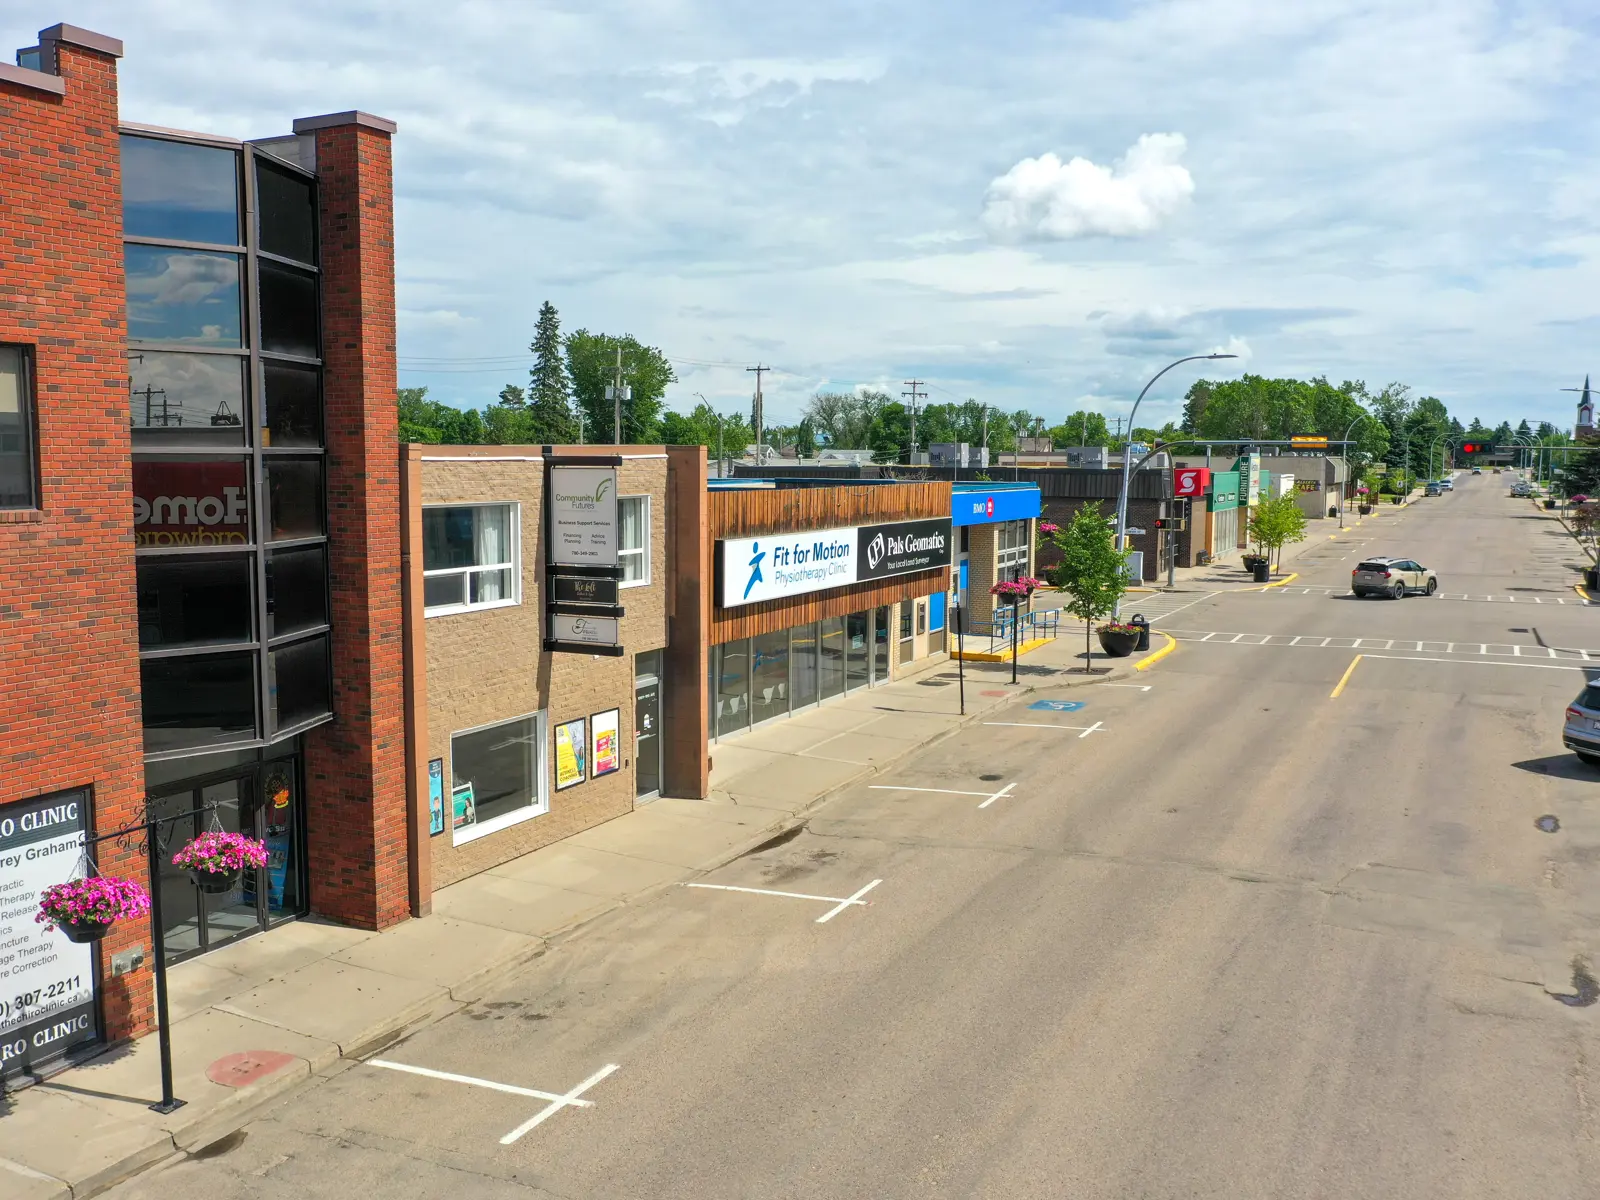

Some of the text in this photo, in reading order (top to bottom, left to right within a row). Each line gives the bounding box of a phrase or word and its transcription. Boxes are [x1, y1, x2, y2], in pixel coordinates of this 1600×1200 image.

[1240, 461, 1249, 501] FURNITURE
[556, 493, 594, 503] Community
[571, 502, 595, 510] Futures
[973, 502, 986, 514] BMO
[773, 540, 850, 567] Fit for Motion
[887, 531, 945, 556] Pals Geomatics
[775, 560, 848, 588] Physiotherapy Clinic
[887, 556, 930, 570] Your Local Land Surveyor
[0, 802, 78, 838] O CLINIC
[25, 839, 77, 861] Graham
[1, 904, 38, 920] Release
[17, 941, 54, 959] Therapy
[12, 953, 58, 975] Correction
[15, 975, 80, 1010] 307-2211
[33, 1013, 89, 1047] CLINIC
